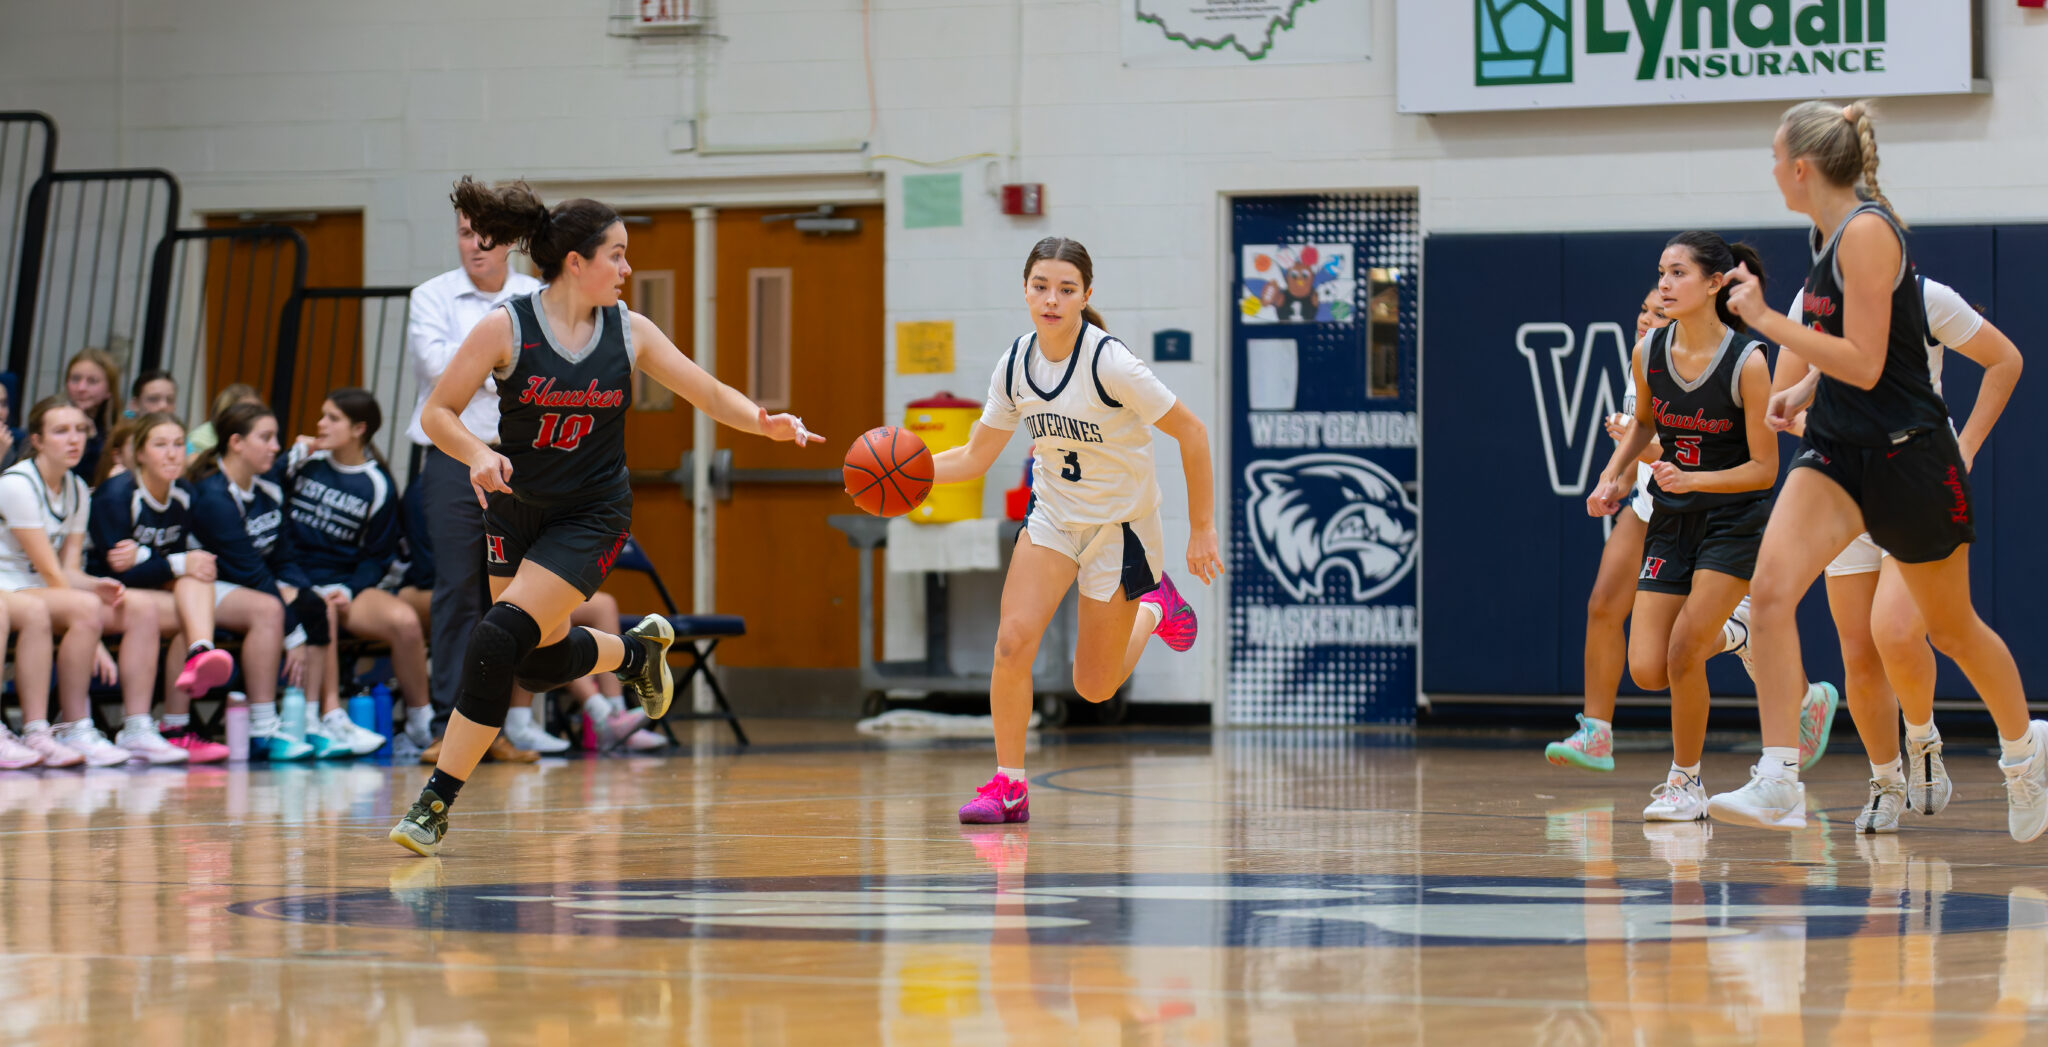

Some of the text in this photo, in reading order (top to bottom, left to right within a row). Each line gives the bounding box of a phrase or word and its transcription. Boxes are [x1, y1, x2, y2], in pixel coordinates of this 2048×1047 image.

[1665, 48, 1887, 79] INSURANCE
[519, 375, 624, 407] Hawken
[1024, 413, 1103, 443] OLVERINES
[1249, 411, 1418, 448] WEST GEAUGA
[1652, 396, 1733, 434] Hawken
[532, 413, 594, 451] 10
[1057, 448, 1082, 482] 3
[1675, 436, 1702, 466] 5
[486, 533, 508, 564] H
[1639, 556, 1666, 580] H
[1247, 605, 1418, 645] BASKETBALL
